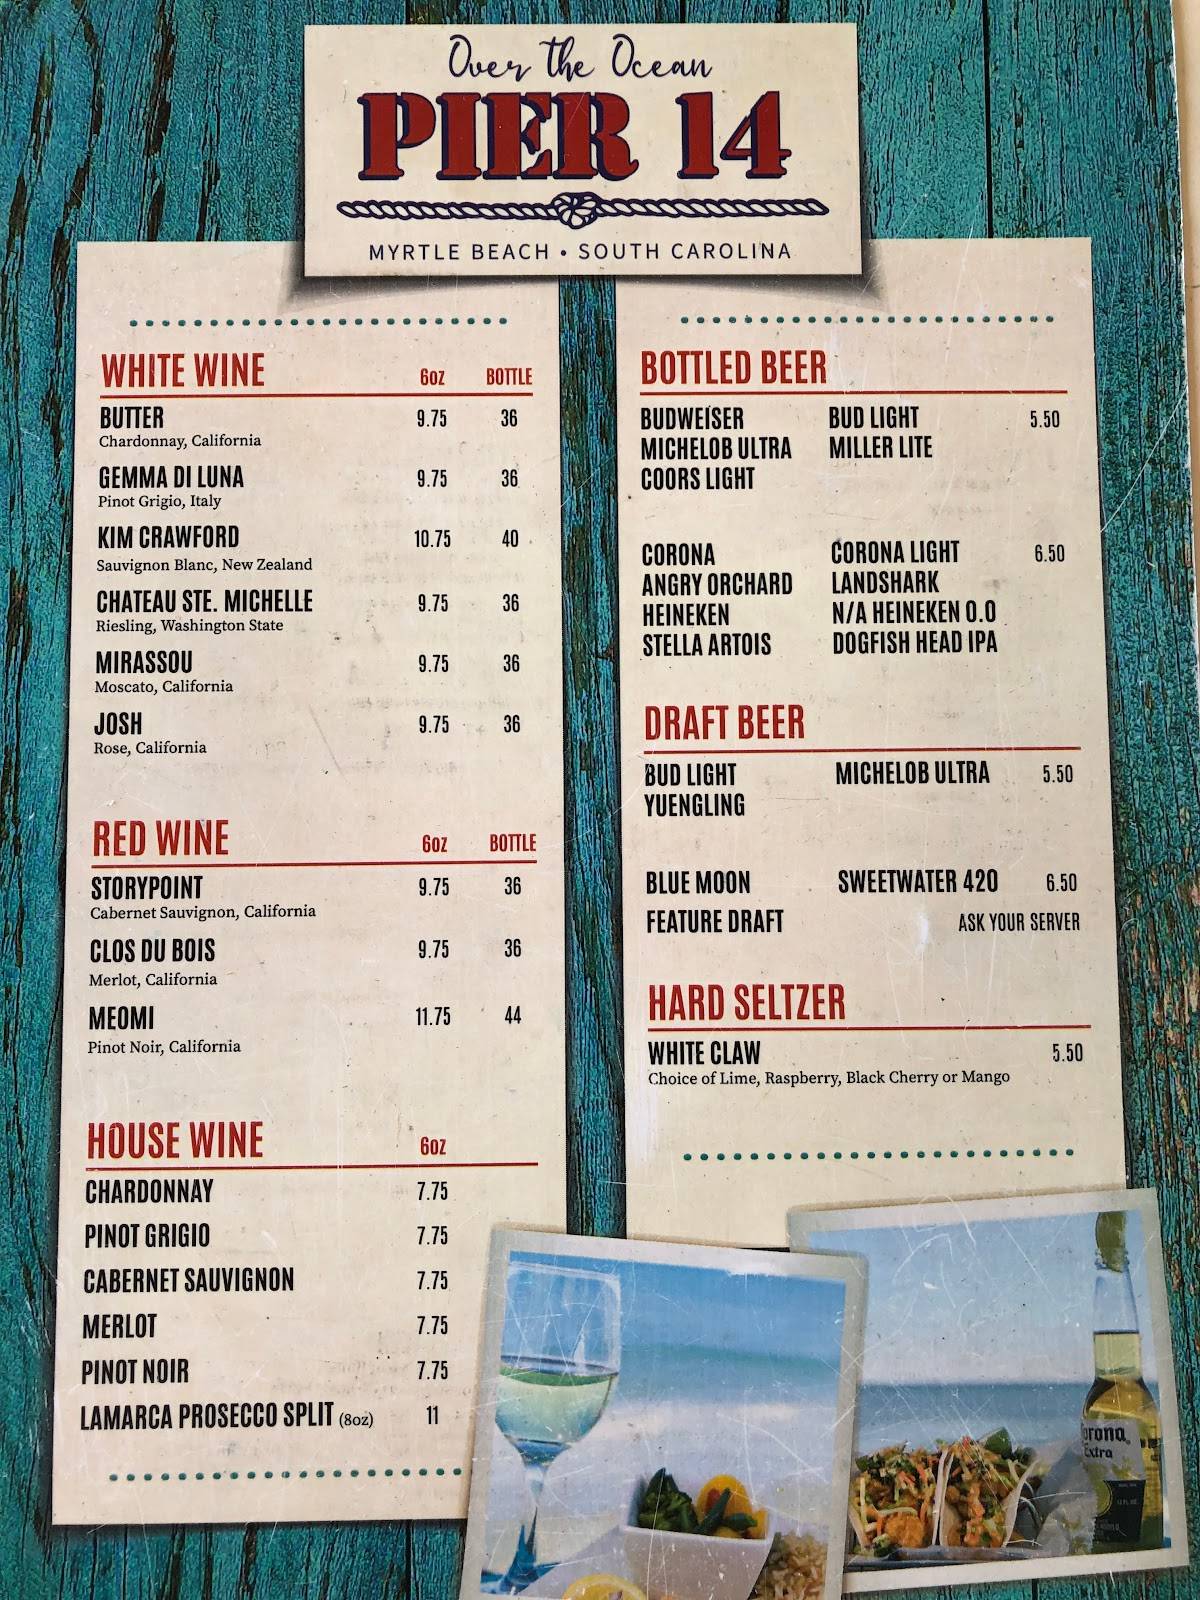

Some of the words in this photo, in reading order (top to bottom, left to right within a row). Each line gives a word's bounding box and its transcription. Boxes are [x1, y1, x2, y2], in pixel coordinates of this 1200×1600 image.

[449, 34, 531, 82] Over
[539, 36, 594, 82] the
[612, 34, 712, 78] Ocean
[357, 92, 639, 181] PIER
[675, 91, 792, 179] 14
[370, 244, 459, 260] MYRTLE
[473, 244, 547, 259] BEACH
[579, 243, 658, 259] SOUTH
[672, 243, 790, 259] CAROLINA
[102, 354, 184, 387] WHITE
[194, 353, 264, 386] WINE
[421, 368, 444, 385] 6oz
[487, 368, 532, 385] BOTTLE
[642, 351, 750, 384] BOTTLED
[762, 350, 826, 383] BEER
[101, 406, 163, 428] BUTTER
[418, 410, 446, 427] 9.75
[501, 409, 517, 426] 36
[641, 407, 743, 430] BUDWEISER
[829, 407, 864, 428] BUD
[871, 406, 919, 428] LIGHT
[1031, 411, 1059, 427] 5.50
[100, 435, 187, 450] Chardonnay,
[192, 434, 261, 446] California
[642, 437, 732, 460] MICHELOB
[738, 437, 792, 459] ULTRA
[830, 436, 893, 458] MILLER
[900, 436, 932, 458] LITE
[100, 466, 167, 488] GEMMA
[174, 466, 191, 488] DI
[198, 466, 244, 488] LUNA
[418, 470, 447, 487] 9.75
[502, 469, 517, 487] 36
[642, 467, 700, 490] COORS
[706, 467, 755, 489] LIGHT
[98, 495, 134, 507] Pinot
[139, 495, 185, 510] Grigio,
[191, 494, 221, 510] Italy
[99, 526, 132, 548] KIM
[140, 525, 239, 548] CRAWFORD
[415, 530, 450, 547] 10.75
[502, 530, 518, 547] 40
[643, 543, 715, 566] CORONA
[832, 540, 904, 564] CORONA
[911, 541, 959, 562] LIGHT
[1035, 545, 1064, 562] 6.50
[97, 559, 169, 574] Sauvignon
[175, 559, 217, 573] Blanc,
[222, 559, 253, 570] New
[257, 558, 312, 570] Zealand
[642, 574, 702, 596] ANGRY
[708, 573, 792, 595] ORCHARD
[833, 571, 939, 594] LANDSHARK
[97, 590, 176, 613] CHATEAU
[183, 590, 217, 612] STE.
[225, 590, 312, 612] MICHELLE
[419, 594, 448, 612] 9.75
[503, 594, 519, 611] 36
[833, 602, 867, 624] N/A
[873, 600, 959, 623] HEINEKEN
[966, 600, 996, 622] 0.0
[643, 603, 729, 626] HEINEKEN
[96, 619, 156, 635] Riesling,
[161, 619, 245, 634] Washington
[249, 620, 283, 631] State
[643, 634, 703, 656] STELLA
[708, 633, 771, 655] ARTOIS
[834, 631, 909, 654] DOGFISH
[917, 631, 962, 653] HEAD
[969, 630, 997, 652] IPA
[96, 651, 192, 673] MIRASSOU
[419, 655, 448, 672] 9.75
[504, 654, 519, 672] 36
[95, 681, 157, 695] Moscato,
[163, 680, 233, 692] California
[94, 712, 141, 735] JOSH
[419, 716, 449, 733] 9.75
[504, 715, 520, 732] 36
[646, 705, 728, 740] DRAFT
[738, 704, 804, 739] BEER
[94, 742, 131, 757] Rose,
[136, 741, 206, 753] California
[645, 764, 680, 786] BUD
[688, 763, 736, 785] LIGHT
[836, 761, 929, 784] MICHELOB
[935, 761, 990, 783] ULTRA
[1043, 765, 1073, 782] 5.50
[644, 793, 744, 816] YUENGLING
[94, 821, 145, 856] RED
[156, 820, 228, 855] WINE
[423, 835, 447, 852] 6oz
[490, 834, 536, 852] BOTTLE
[92, 876, 203, 900] STORYPOINT
[419, 878, 449, 896] 9.75
[505, 877, 521, 895] 36
[647, 871, 690, 894] BLUE
[696, 871, 750, 893] MOON
[839, 870, 956, 893] SWEETWATER
[964, 869, 998, 892] 420
[1047, 873, 1076, 891] 6.50
[91, 906, 156, 919] Cabernet
[160, 906, 239, 921] Sauvignon,
[245, 904, 316, 917] California
[647, 910, 722, 933] FEATURE
[729, 910, 783, 932] DRAFT
[959, 913, 985, 931] ASK
[989, 913, 1024, 931] YOUR
[1031, 913, 1079, 931] SERVER
[91, 939, 135, 962] CLOS
[142, 939, 165, 962] DU
[173, 938, 215, 962] BOIS
[419, 940, 448, 958] 9.75
[505, 939, 521, 957] 36
[90, 973, 140, 989] Merlot,
[146, 972, 217, 985] California
[650, 985, 724, 1020] HARD
[734, 984, 845, 1020] SELTZER
[89, 1006, 153, 1030] MEOMI
[416, 1007, 450, 1025] 11.75
[505, 1006, 521, 1024] 44
[88, 1041, 125, 1053] Pinot
[130, 1040, 164, 1056] Noir,
[169, 1040, 241, 1052] California
[648, 1041, 704, 1065] WHITE
[711, 1041, 760, 1064] CLAW
[1053, 1043, 1082, 1062] 5.50
[649, 1072, 697, 1085] Choice
[702, 1071, 717, 1084] of
[720, 1072, 760, 1087] Lime,
[765, 1071, 841, 1087] Raspberry,
[847, 1071, 885, 1083] Black
[890, 1070, 938, 1086] Cherry
[943, 1074, 957, 1082] or
[962, 1071, 1009, 1085] Mango
[88, 1122, 179, 1159] HOUSE
[190, 1122, 263, 1158] WINE
[421, 1137, 446, 1155] 6oz
[86, 1179, 213, 1203] CHARDONNAY
[418, 1182, 447, 1200] 7.75
[85, 1224, 140, 1248] PINOT
[146, 1223, 209, 1247] GRIGIO
[417, 1226, 447, 1244] 7.75
[84, 1269, 179, 1293] CABERNET
[185, 1267, 293, 1292] SAUVIGNON
[417, 1271, 447, 1289] 7.75
[83, 1314, 157, 1338] MERLOT
[417, 1316, 447, 1334] 7.75
[82, 1360, 137, 1384] PINOT
[143, 1359, 188, 1383] NOIR
[418, 1361, 448, 1379] 7.75
[81, 1405, 172, 1430] LAMARCA
[179, 1403, 277, 1428] PROSECCO
[284, 1402, 334, 1426] SPLIT
[340, 1412, 373, 1428] (8oz)
[427, 1406, 438, 1424] 11
